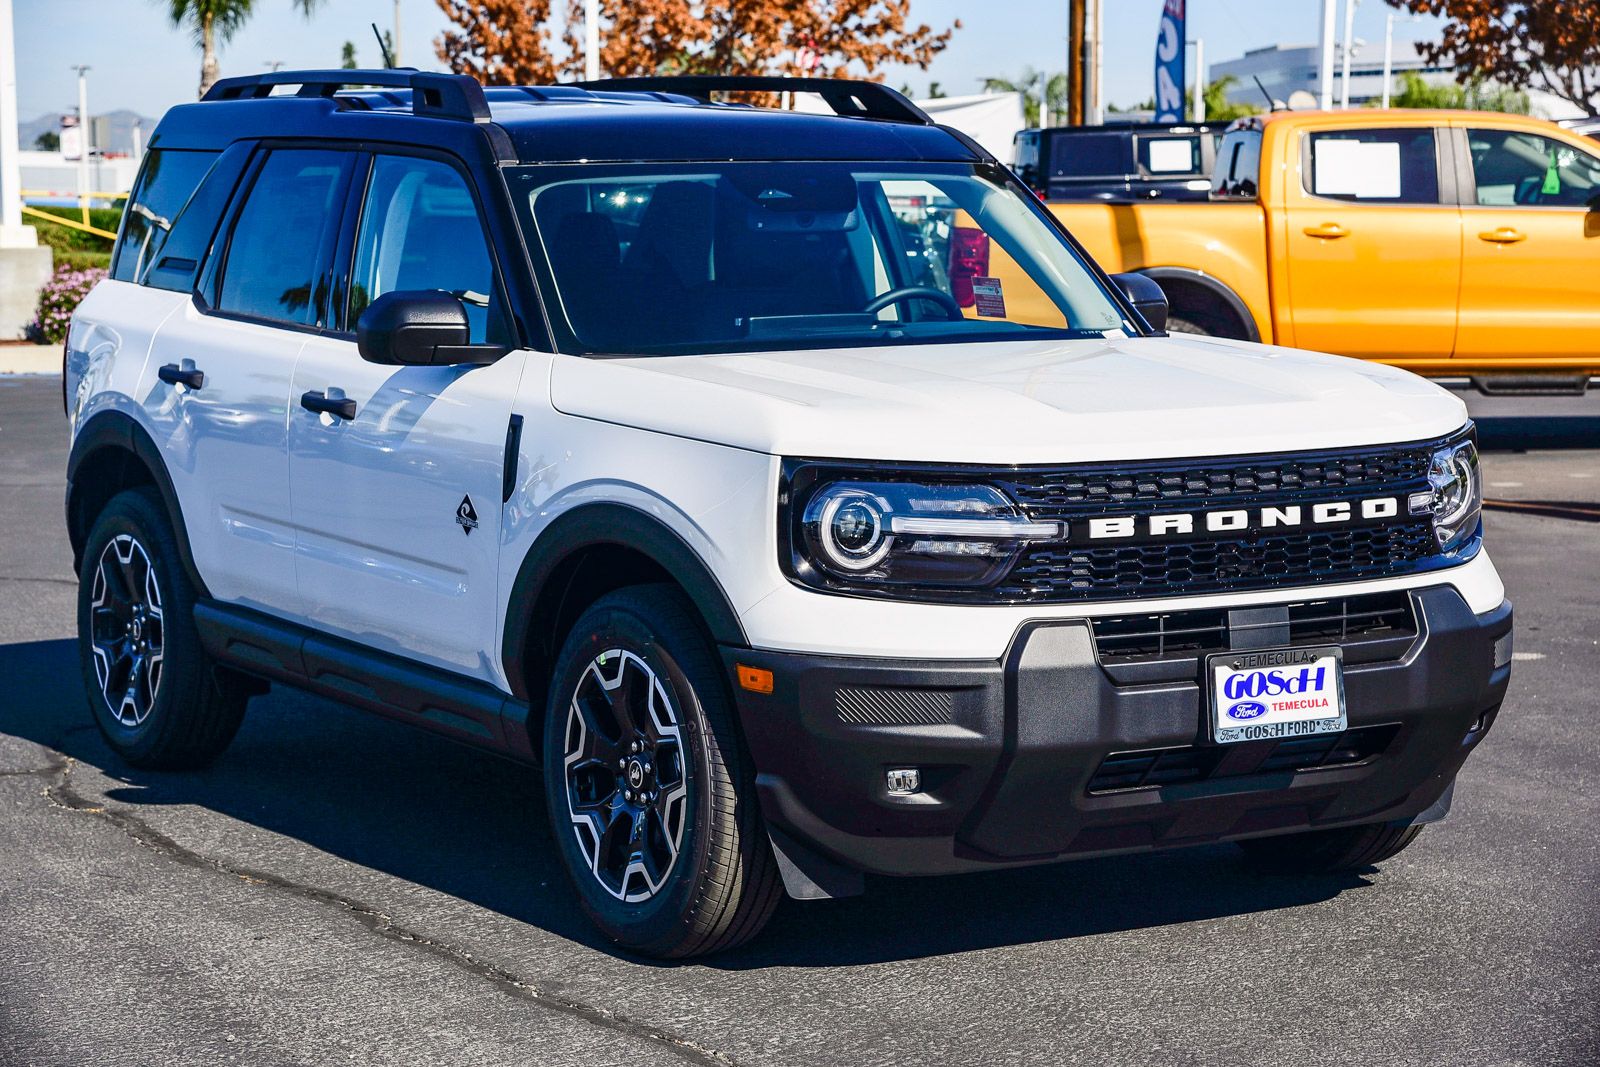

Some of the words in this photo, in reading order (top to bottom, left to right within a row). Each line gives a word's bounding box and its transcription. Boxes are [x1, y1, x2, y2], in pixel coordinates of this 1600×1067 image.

[1089, 497, 1397, 539] BRONCO
[1241, 651, 1309, 668] TEMECULA
[1234, 703, 1259, 718] Ford
[1272, 698, 1329, 711] TEMECULA
[1220, 729, 1240, 741] Ford
[1287, 720, 1316, 735] FORD
